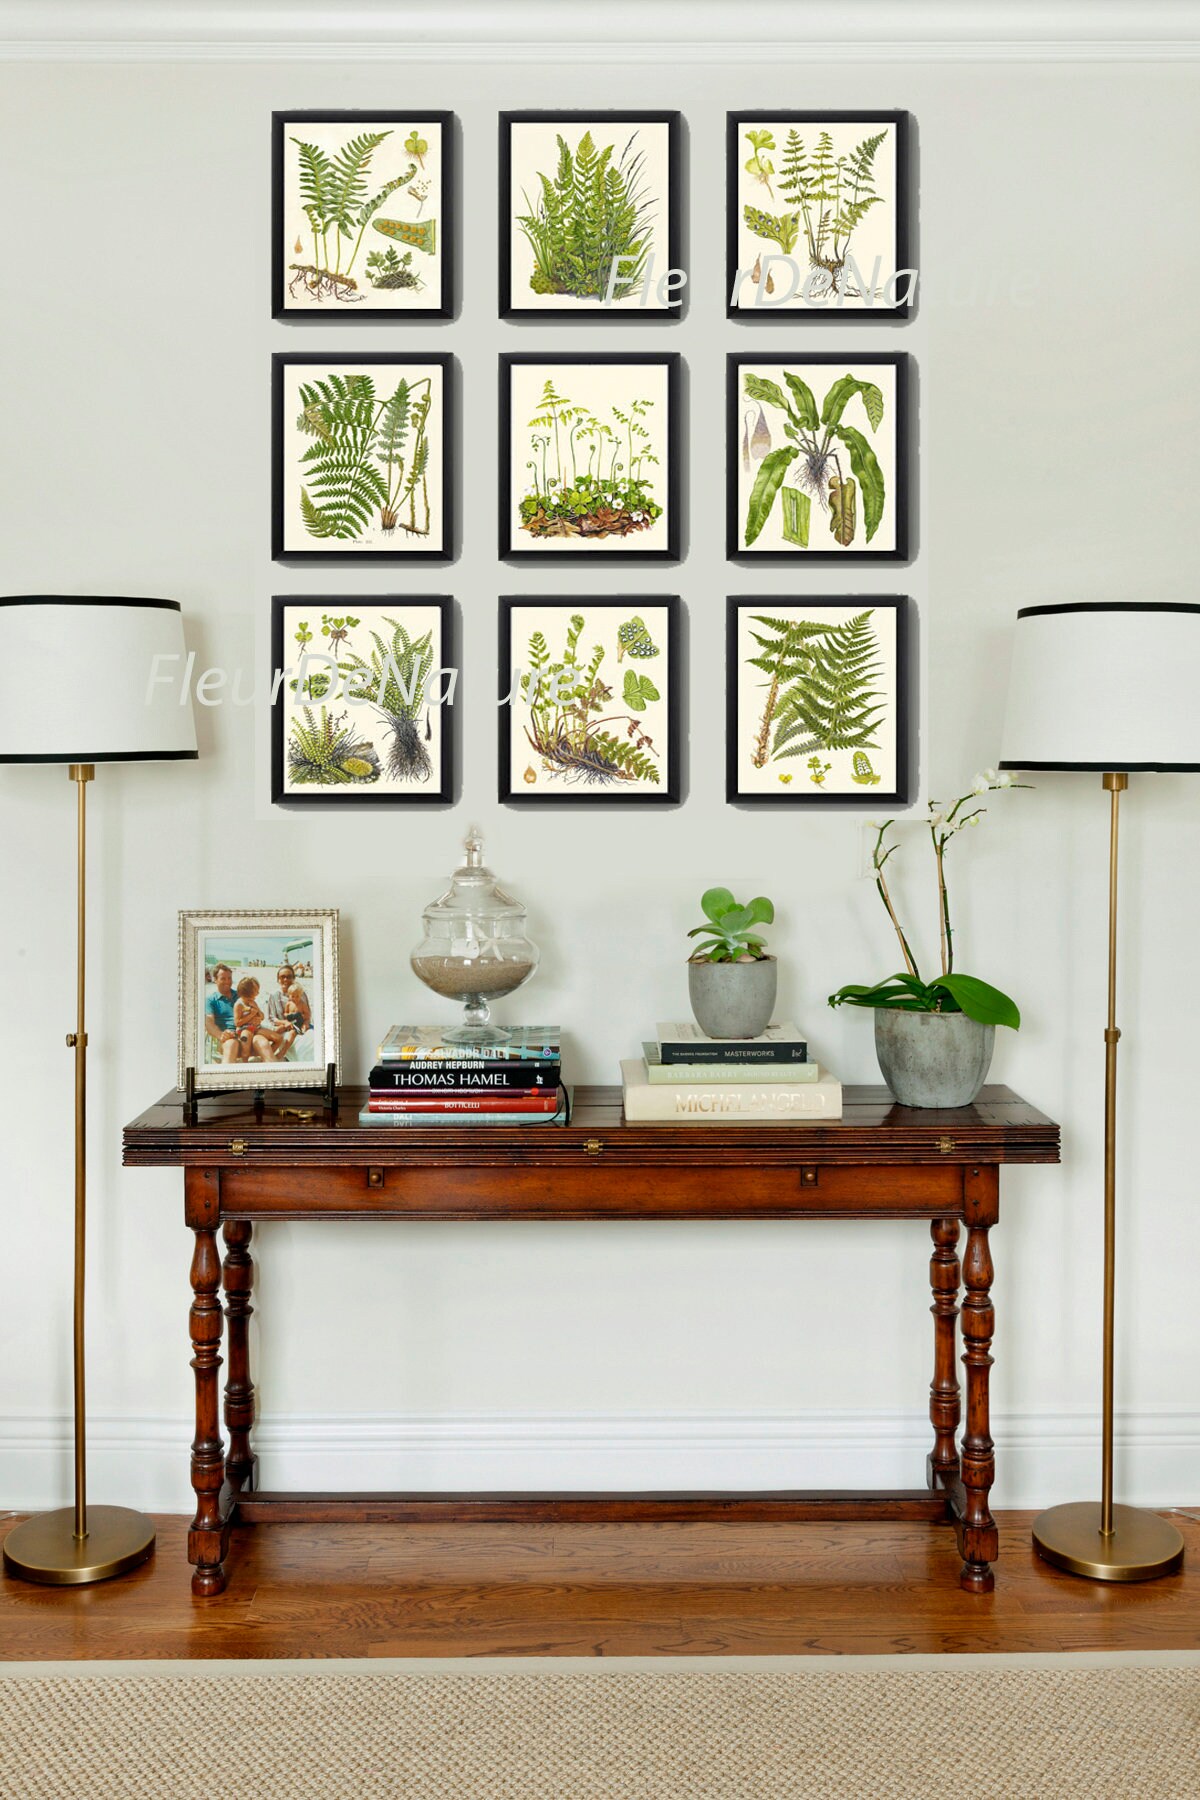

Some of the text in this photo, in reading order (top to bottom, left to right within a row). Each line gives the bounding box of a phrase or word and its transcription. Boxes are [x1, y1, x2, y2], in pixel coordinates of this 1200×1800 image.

[409, 1061, 442, 1069] AUDREY
[445, 1061, 485, 1069] HEPBURN
[393, 1073, 510, 1086] THOMAS HAMEL
[444, 1101, 480, 1109] BOTTICELLI
[675, 1093, 826, 1113] MICHELANGELO
